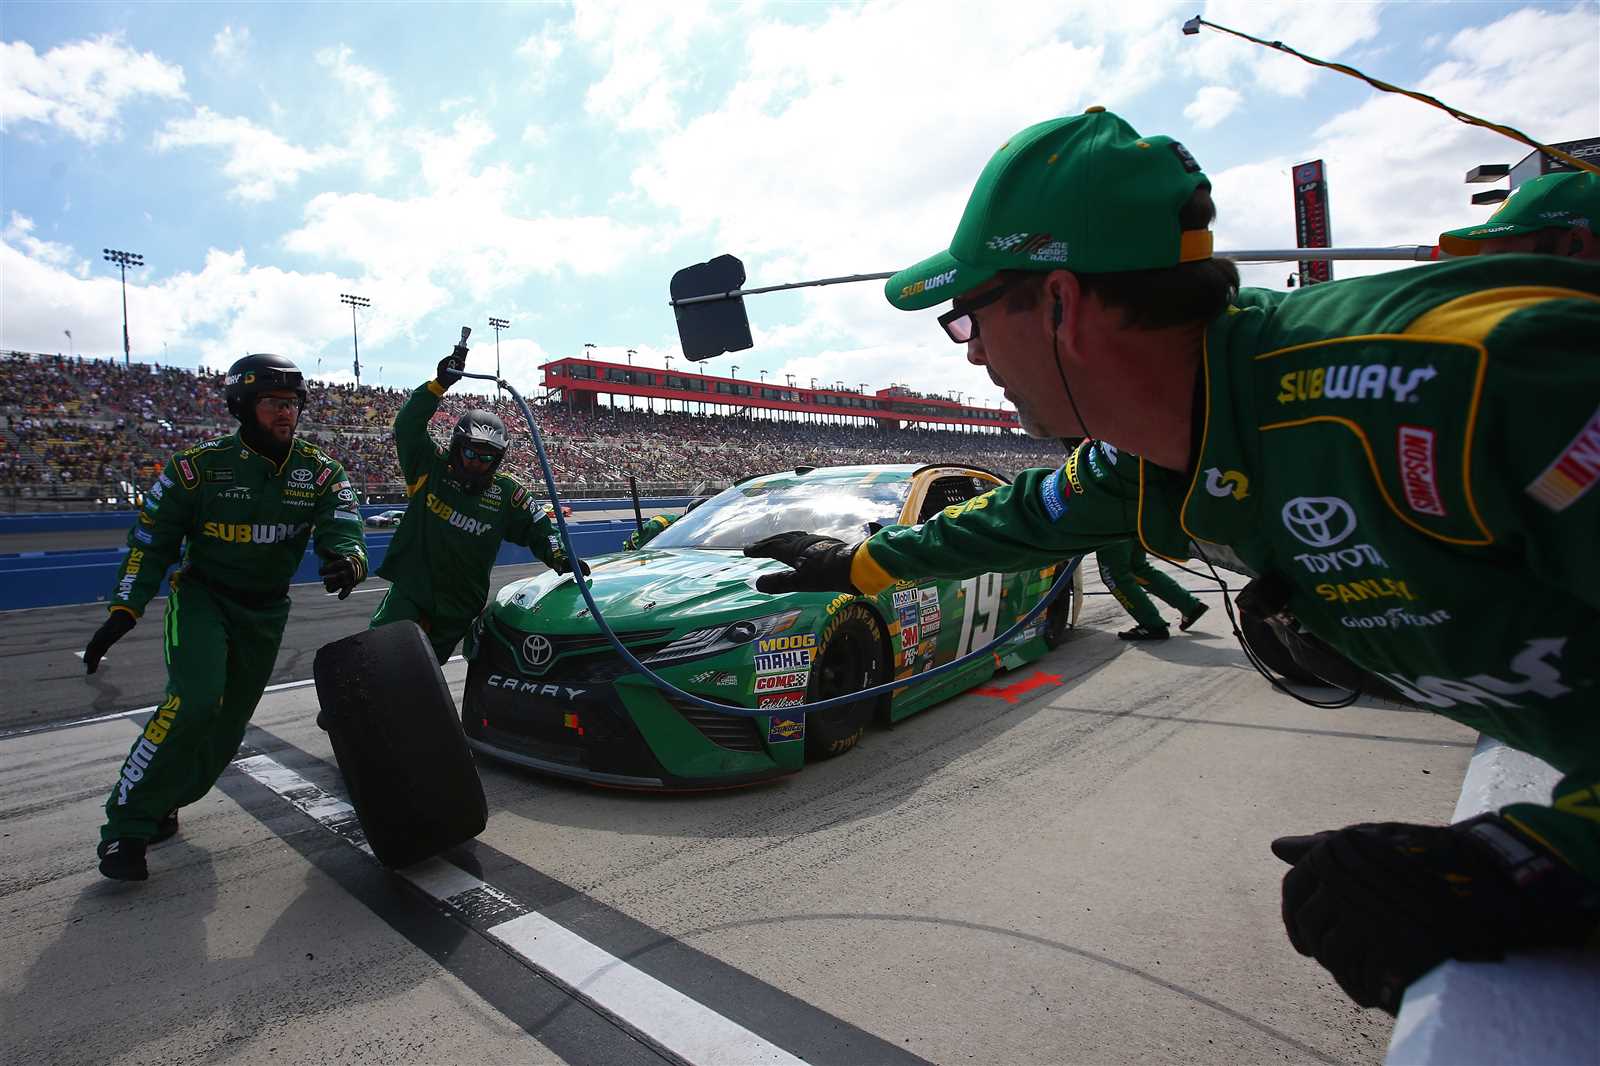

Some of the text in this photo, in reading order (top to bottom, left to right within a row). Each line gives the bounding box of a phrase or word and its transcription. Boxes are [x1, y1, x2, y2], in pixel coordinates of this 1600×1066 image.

[900, 268, 958, 298] SUBWAY
[1277, 364, 1438, 404] SUBWAY
[287, 480, 315, 489] TOYOTA
[1402, 431, 1440, 513] SIMPSON
[425, 492, 493, 536] SUBWAY
[204, 521, 317, 545] SUBWAY
[118, 546, 144, 601] SUBWAY
[955, 572, 1003, 660] 19
[759, 634, 816, 653] MOOG
[902, 625, 918, 648] 3M
[755, 651, 810, 671] MAHLE
[757, 674, 796, 689] COMP
[760, 696, 805, 709] Edelbrock
[118, 694, 181, 806] SUBWAY
